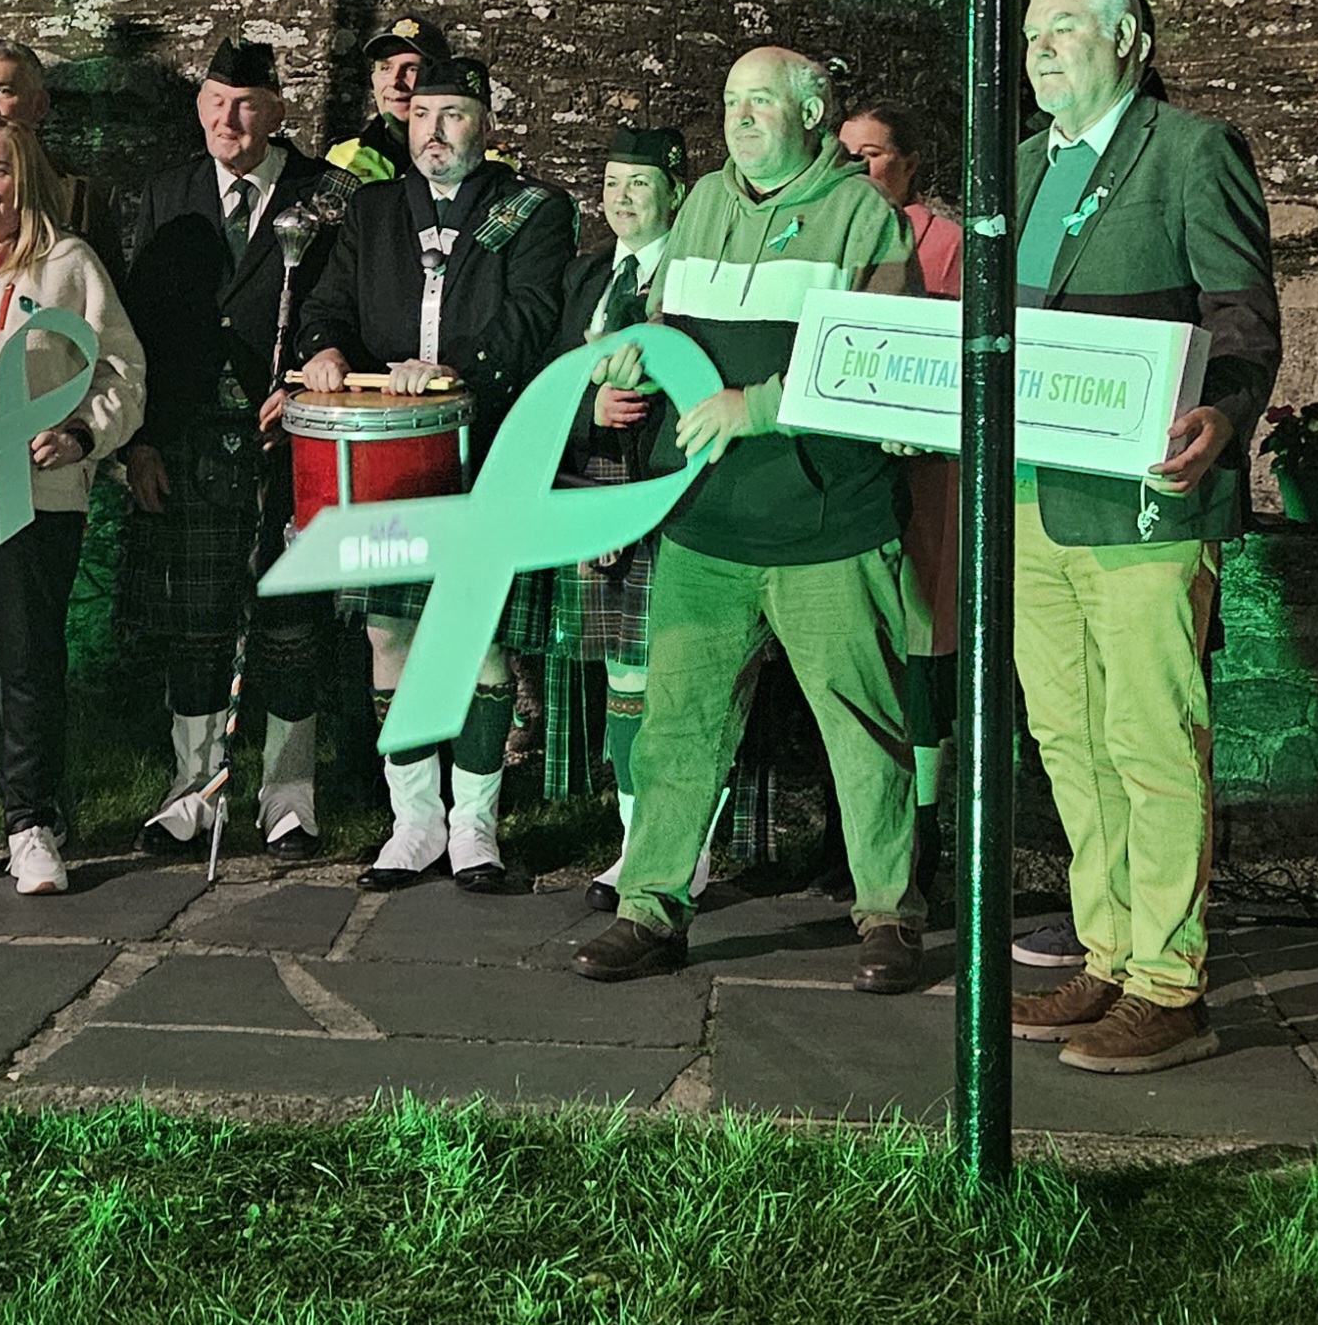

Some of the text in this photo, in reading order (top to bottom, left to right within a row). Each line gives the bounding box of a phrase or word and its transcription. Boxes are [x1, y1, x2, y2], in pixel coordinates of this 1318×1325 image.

[841, 349, 880, 378] END
[884, 354, 960, 389] MENTAL
[1048, 373, 1127, 409] STIGMA
[338, 534, 429, 573] Shine
